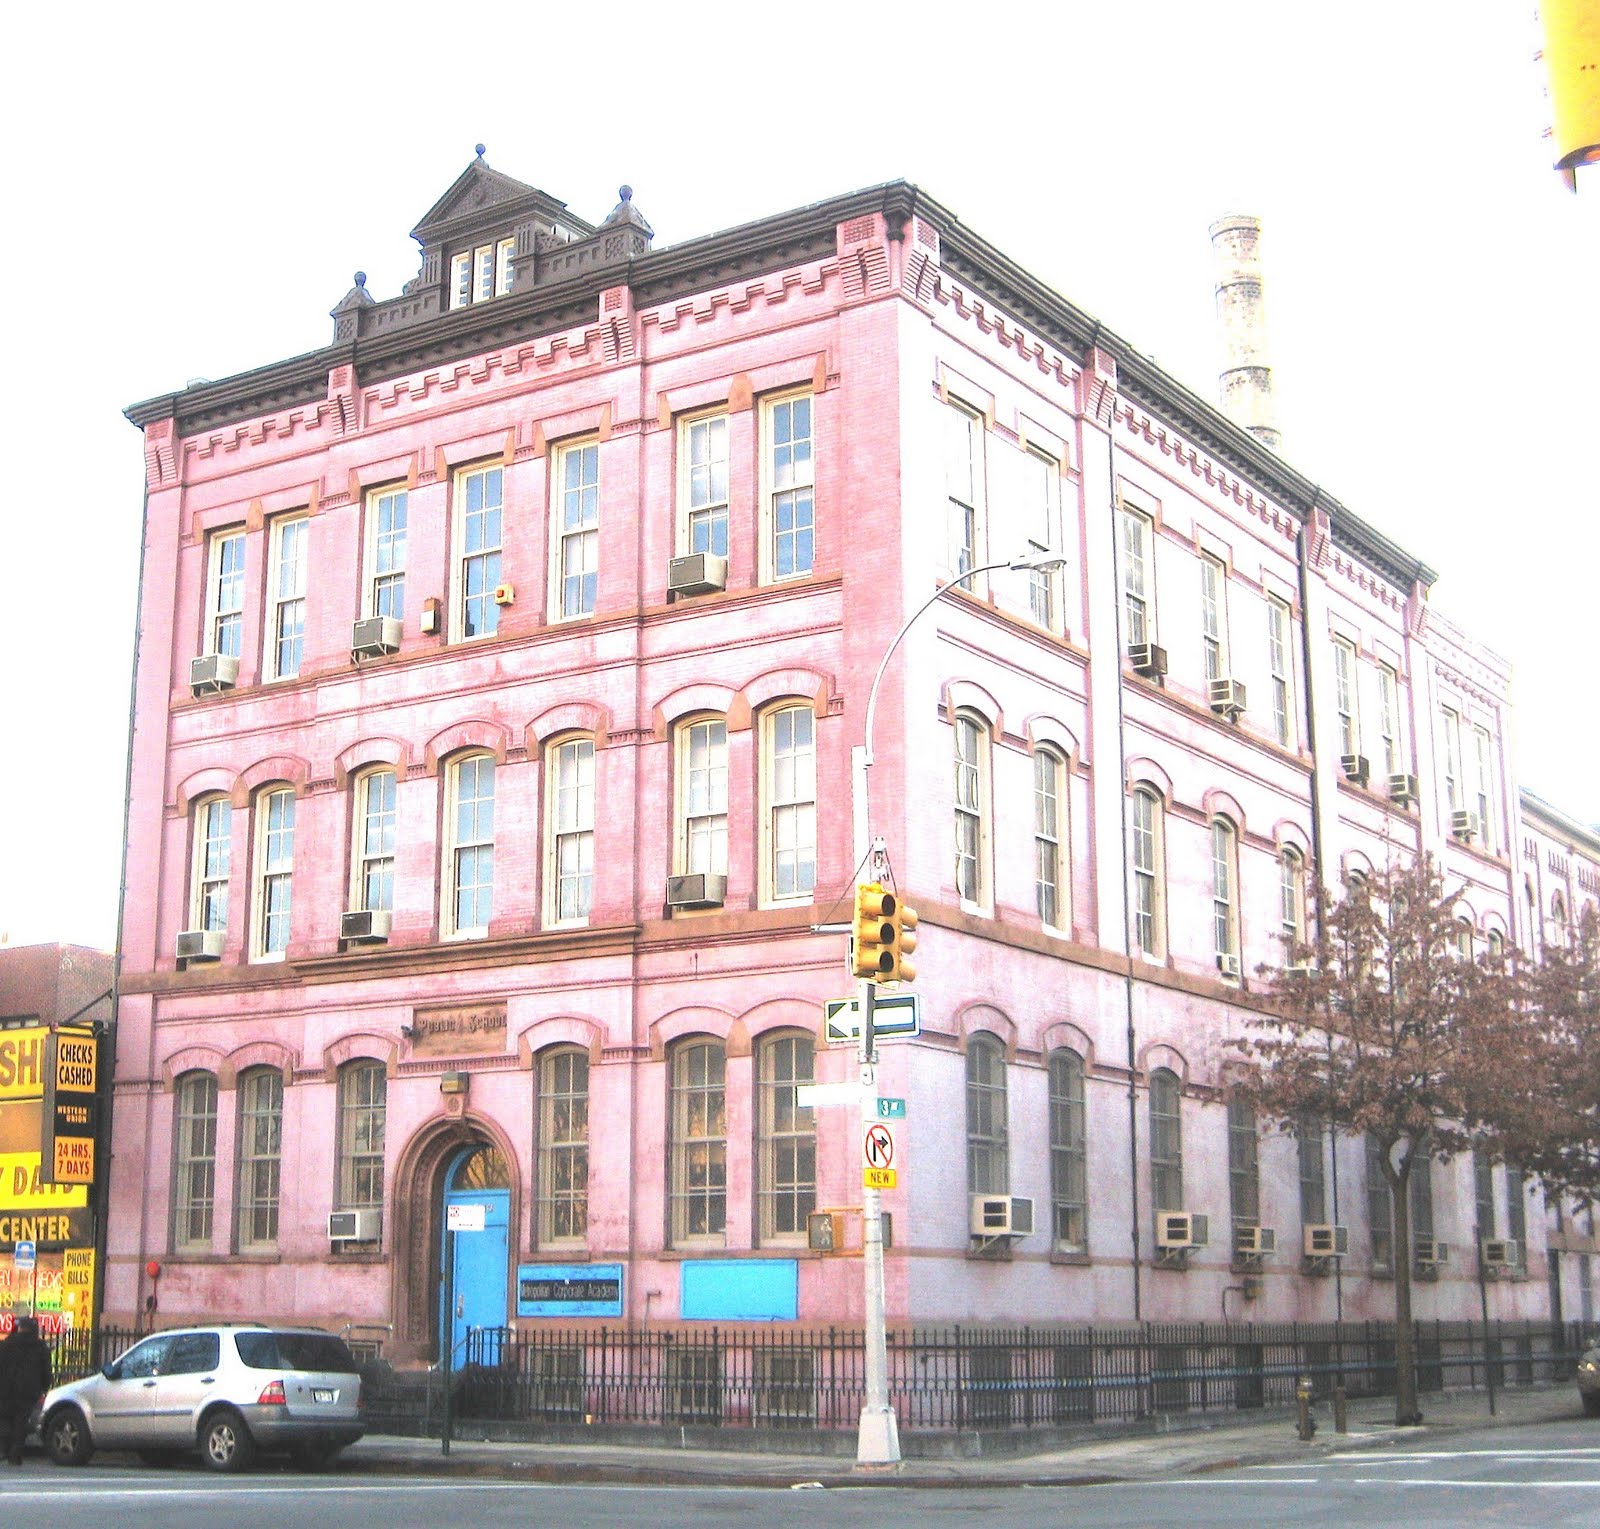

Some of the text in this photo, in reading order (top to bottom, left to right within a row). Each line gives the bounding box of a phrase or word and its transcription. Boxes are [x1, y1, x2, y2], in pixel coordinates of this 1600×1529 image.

[60, 1043, 93, 1065] CHECKS
[60, 1066, 92, 1086] CASHED
[57, 1106, 87, 1115] WESTERN
[66, 1114, 87, 1123] UNION
[58, 1143, 91, 1159] 24 HRS.
[58, 1161, 90, 1175] 7 DAYS
[870, 1172, 890, 1184] NEW
[0, 1215, 70, 1242] CENTER
[66, 1252, 92, 1267] PHONE
[67, 1270, 89, 1285] BILLS
